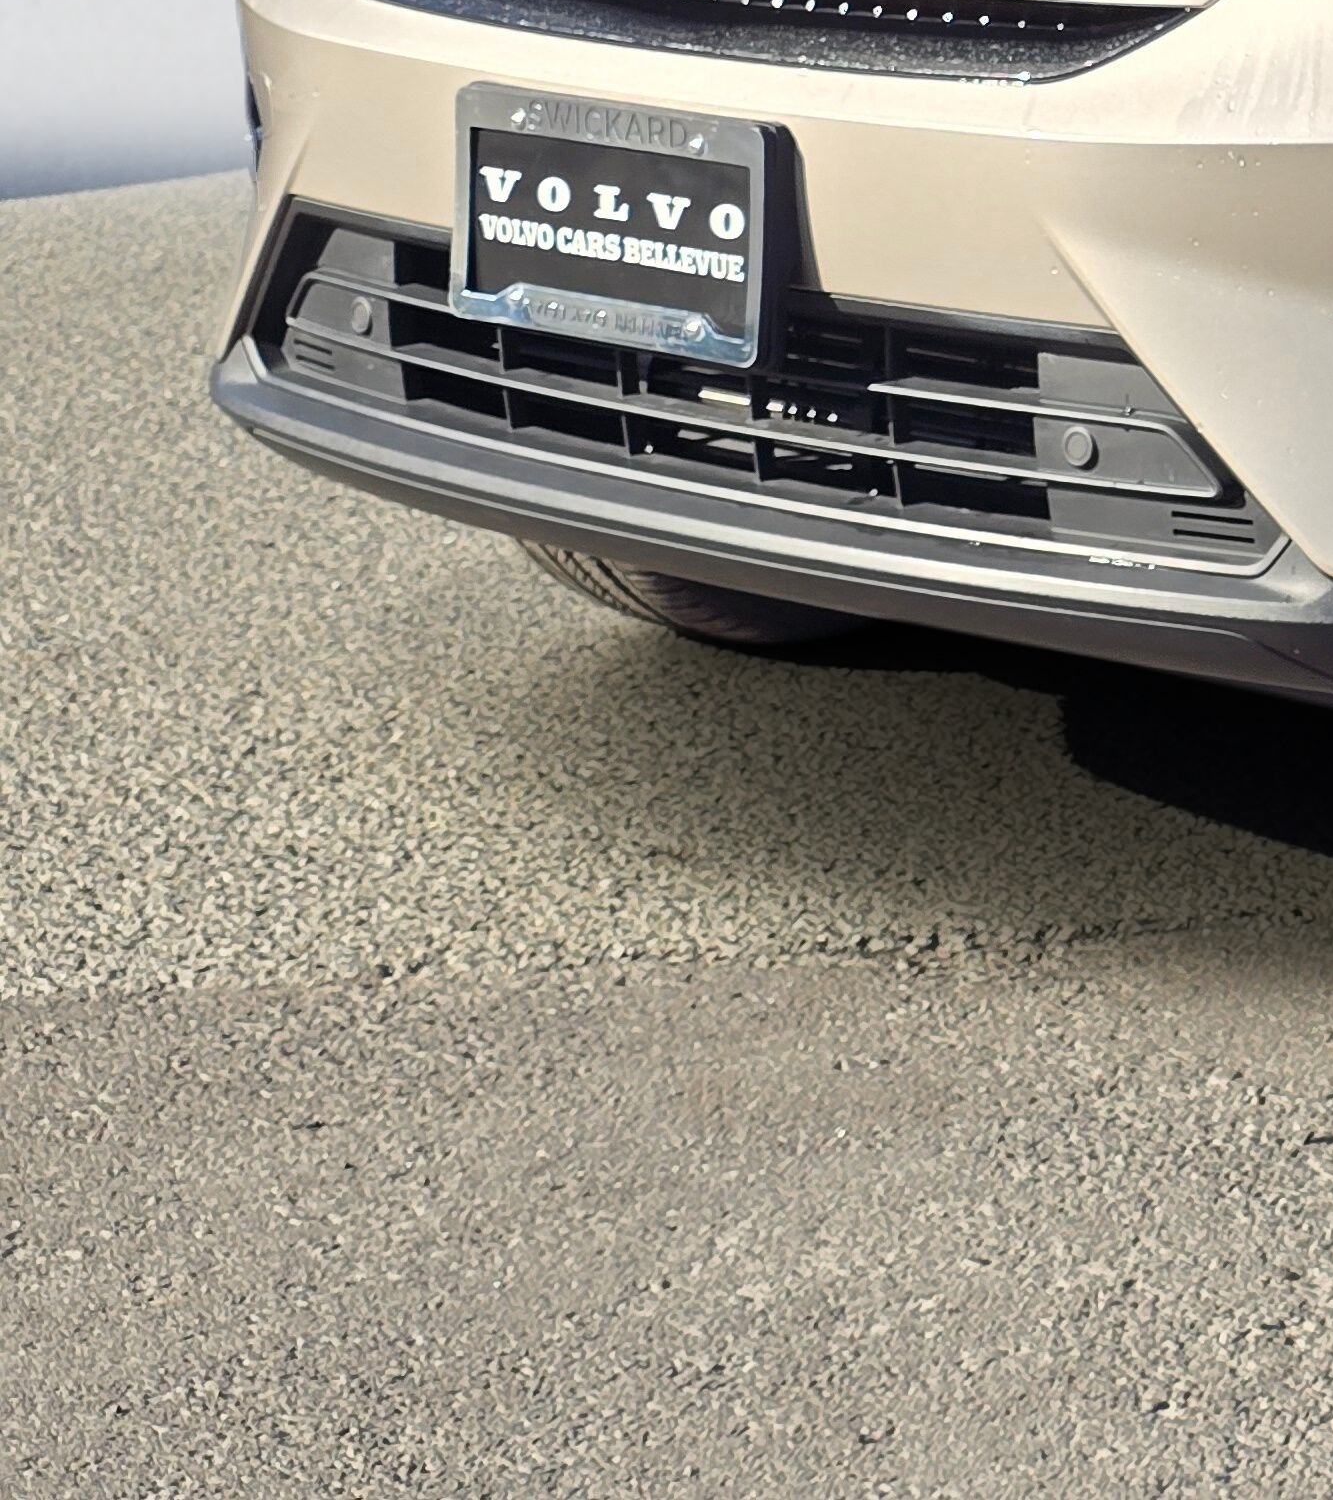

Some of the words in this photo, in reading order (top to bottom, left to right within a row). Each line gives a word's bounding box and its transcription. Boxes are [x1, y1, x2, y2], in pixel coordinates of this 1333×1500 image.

[529, 100, 688, 148] SWICKARD
[479, 166, 745, 239] VOLVO
[478, 214, 554, 250] VOLVO
[556, 228, 621, 261] CARS
[622, 237, 745, 282] BELLEVUE
